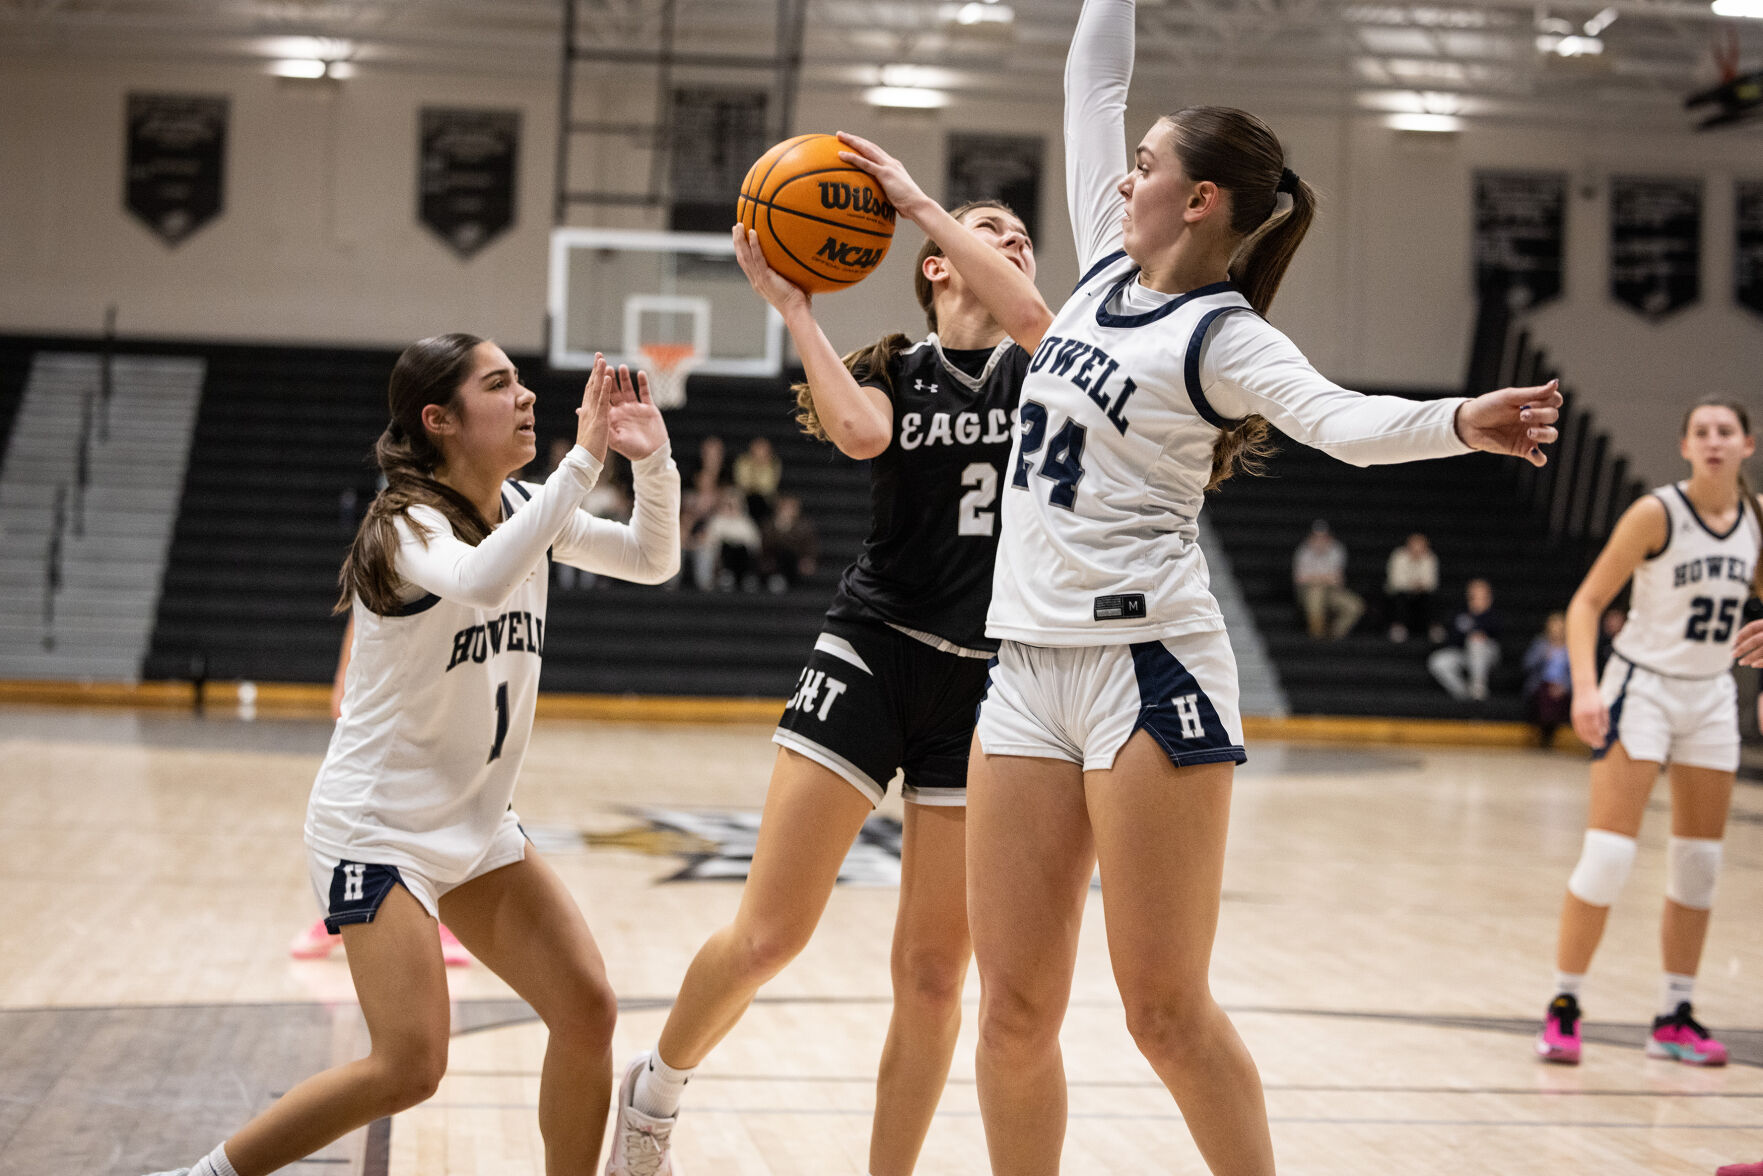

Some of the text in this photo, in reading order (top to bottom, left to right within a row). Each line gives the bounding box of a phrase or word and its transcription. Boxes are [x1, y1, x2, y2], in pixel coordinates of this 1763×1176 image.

[818, 181, 896, 225] Wilson
[816, 236, 883, 268] NCAA
[1026, 336, 1137, 437] OWELL
[1011, 398, 1088, 513] 24
[957, 462, 998, 537] 2
[1128, 600, 1138, 612] M
[1685, 596, 1738, 643] 25
[486, 681, 509, 765] 1
[1171, 693, 1206, 739] H
[343, 864, 366, 902] H
